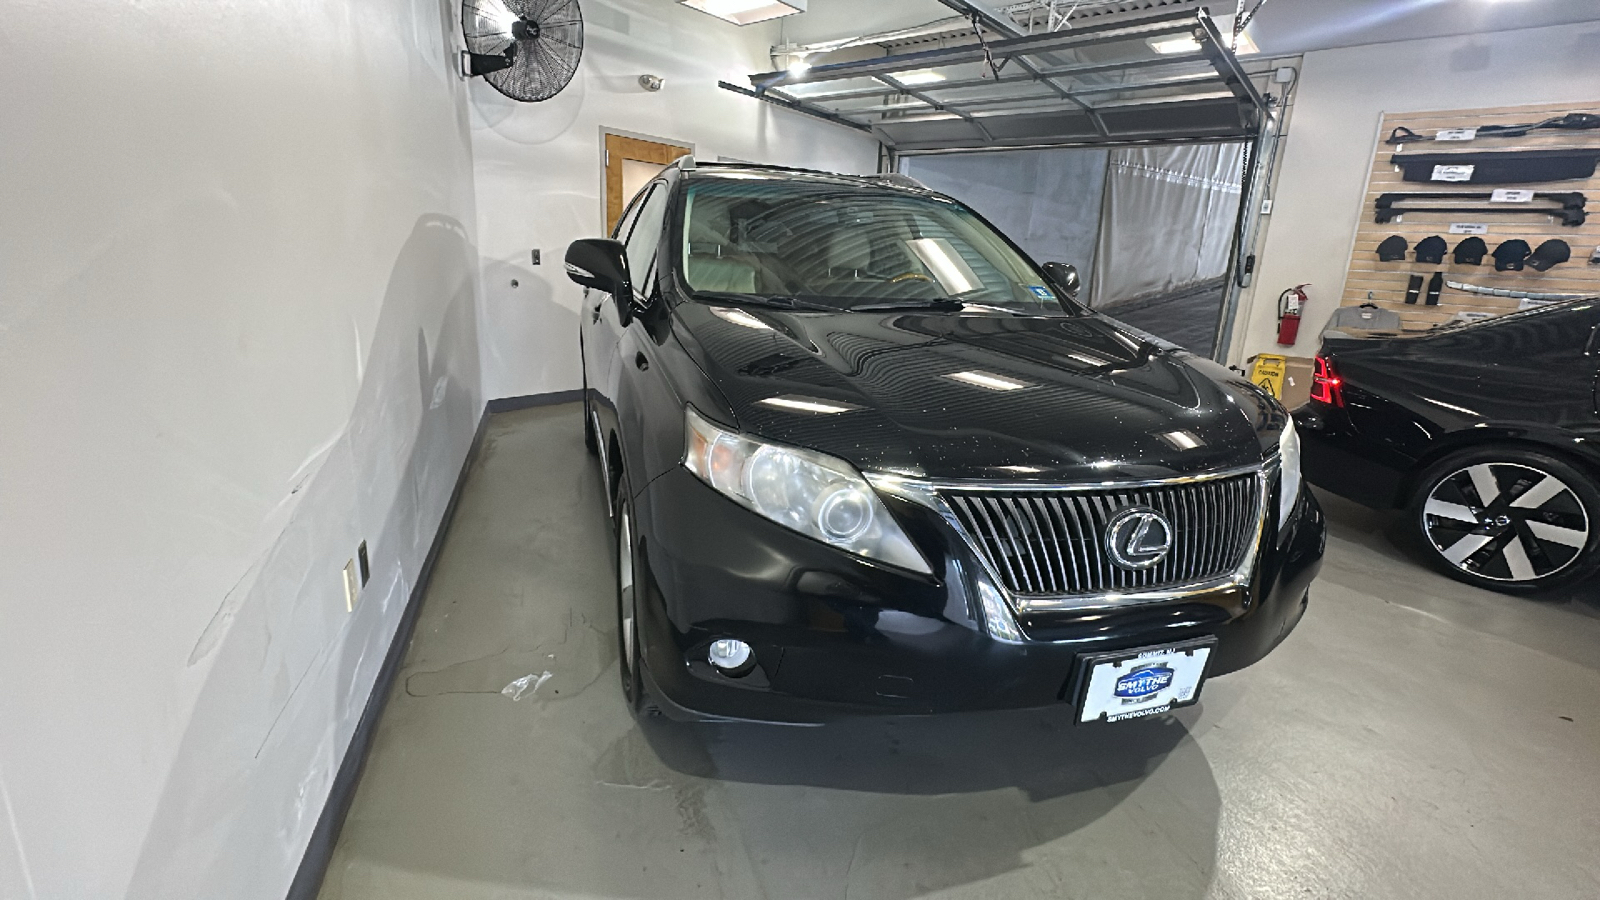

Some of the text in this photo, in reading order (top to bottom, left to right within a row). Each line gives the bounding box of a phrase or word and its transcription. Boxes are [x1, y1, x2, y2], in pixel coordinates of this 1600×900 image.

[1117, 675, 1168, 691] SMYTHE
[1128, 684, 1159, 694] VOLVO
[1107, 705, 1171, 722] SMYTHEVOLVO.COM
